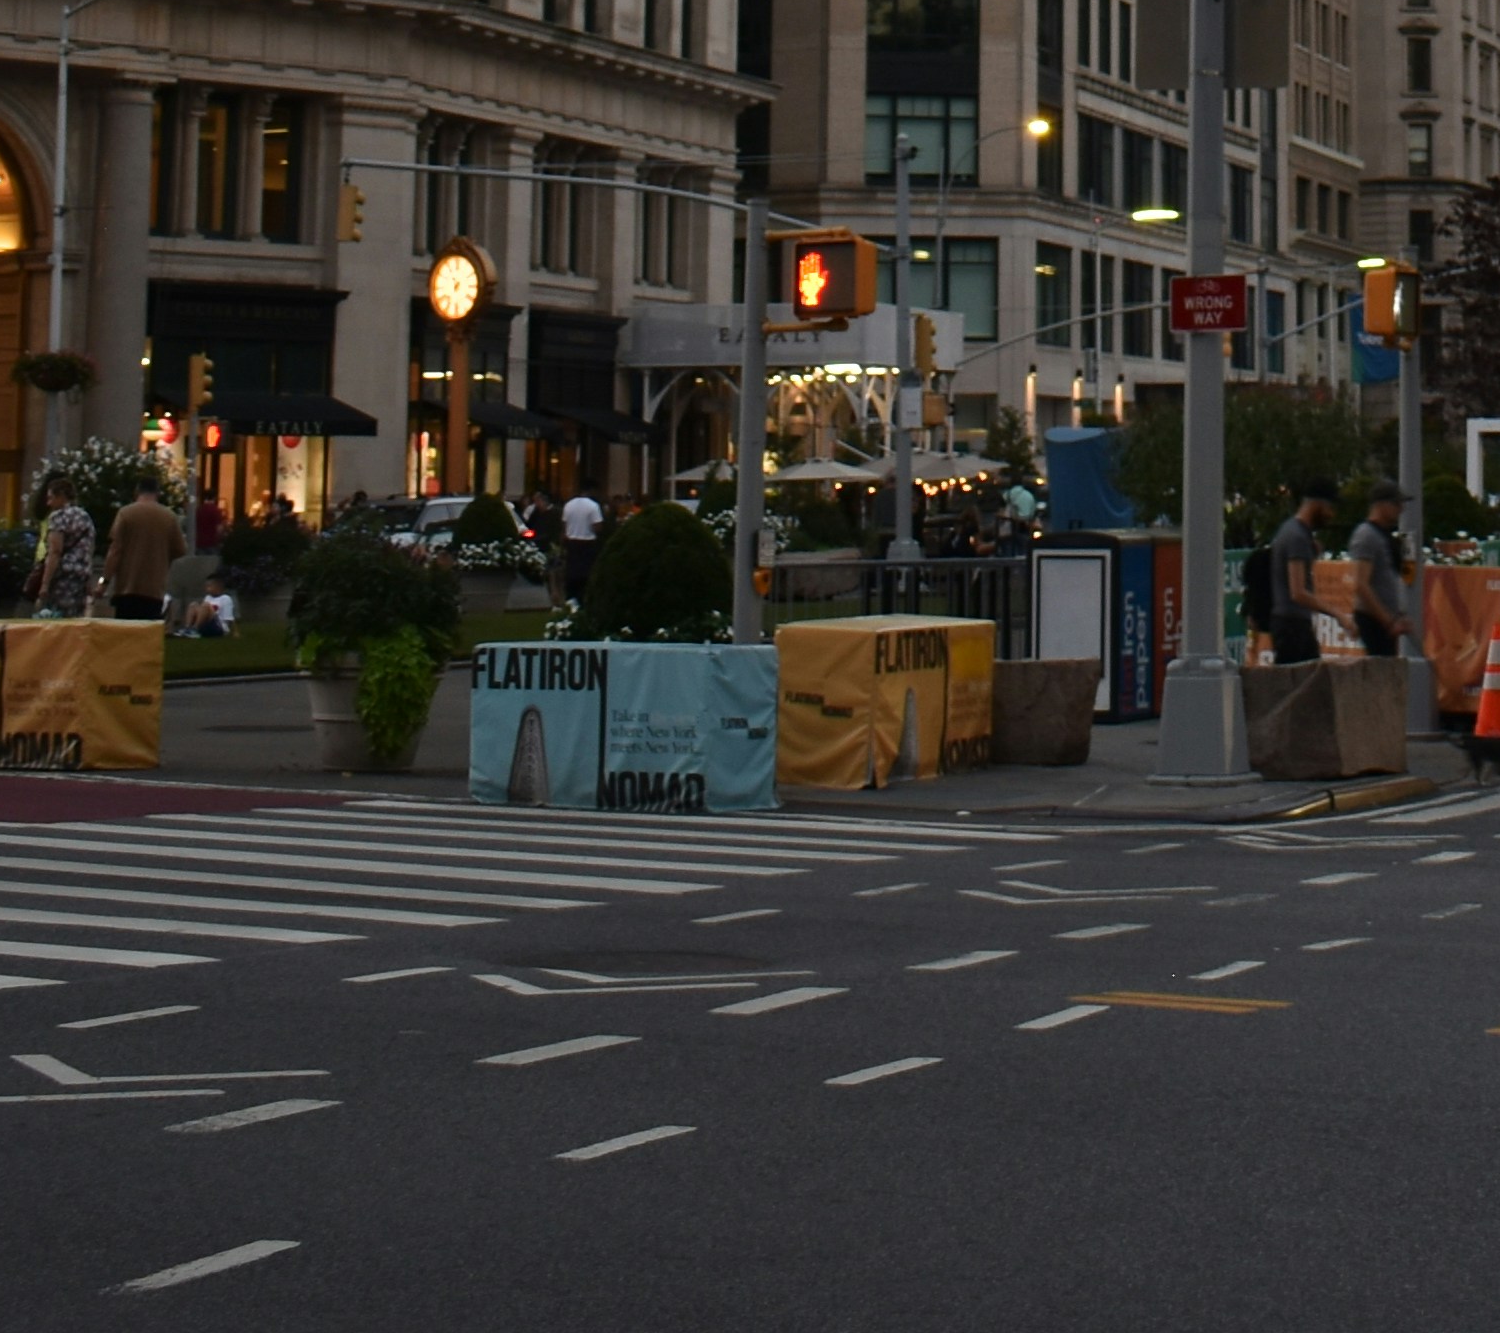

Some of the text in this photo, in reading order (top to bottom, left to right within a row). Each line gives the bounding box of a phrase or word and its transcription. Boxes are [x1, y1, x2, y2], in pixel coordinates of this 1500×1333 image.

[1183, 294, 1233, 310] WRONG
[1193, 311, 1223, 324] WAY
[719, 327, 822, 344] EAALY
[255, 420, 324, 435] EATALY
[874, 627, 949, 674] FLATIRON
[471, 646, 608, 691] FLATIRON
[599, 770, 706, 811] NOMAD
